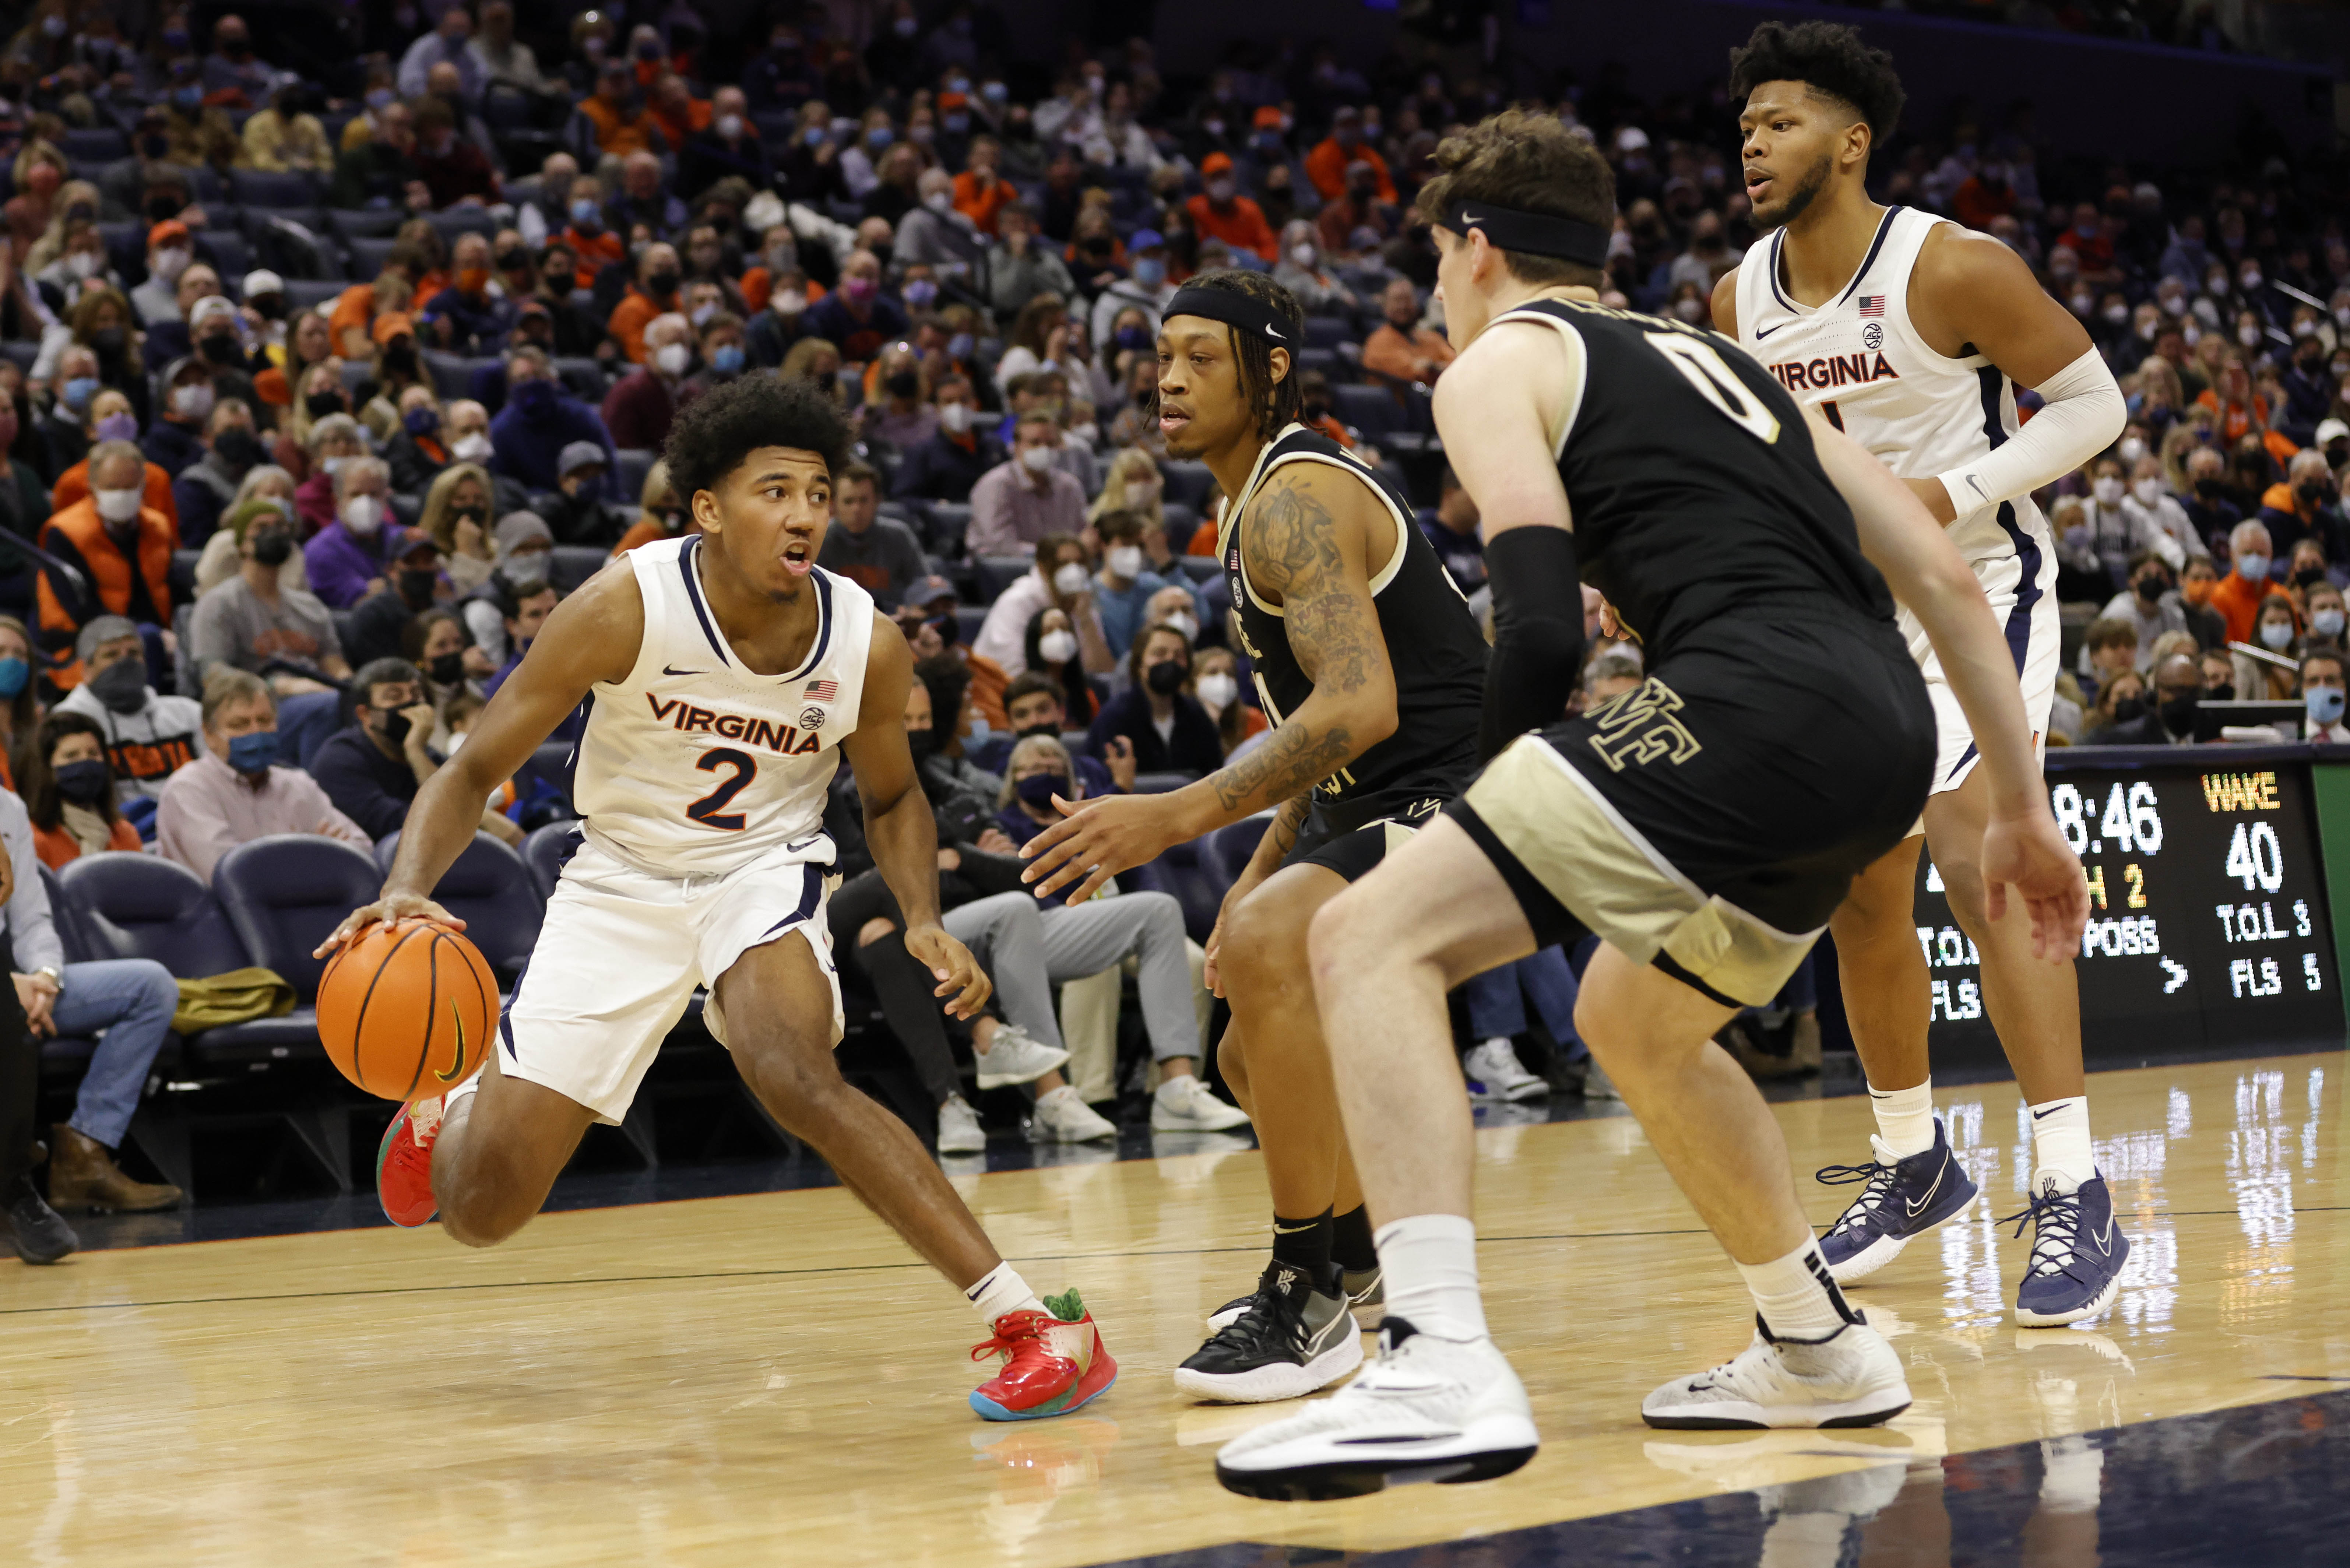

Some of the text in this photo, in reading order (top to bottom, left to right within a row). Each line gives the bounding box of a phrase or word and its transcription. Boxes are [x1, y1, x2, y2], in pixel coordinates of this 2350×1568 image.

[1643, 330, 1781, 445] 0
[645, 692, 820, 756] VIRGINIA
[686, 747, 757, 831] 2
[2201, 771, 2280, 812] WAKE
[2052, 781, 2163, 858] 8:46
[2226, 821, 2283, 894] 40
[2124, 864, 2147, 908] 2
[2082, 915, 2160, 957] POSS
[2293, 899, 2311, 937] 3
[2229, 953, 2322, 998] FLS 5
[1930, 978, 1982, 1022] FLS
